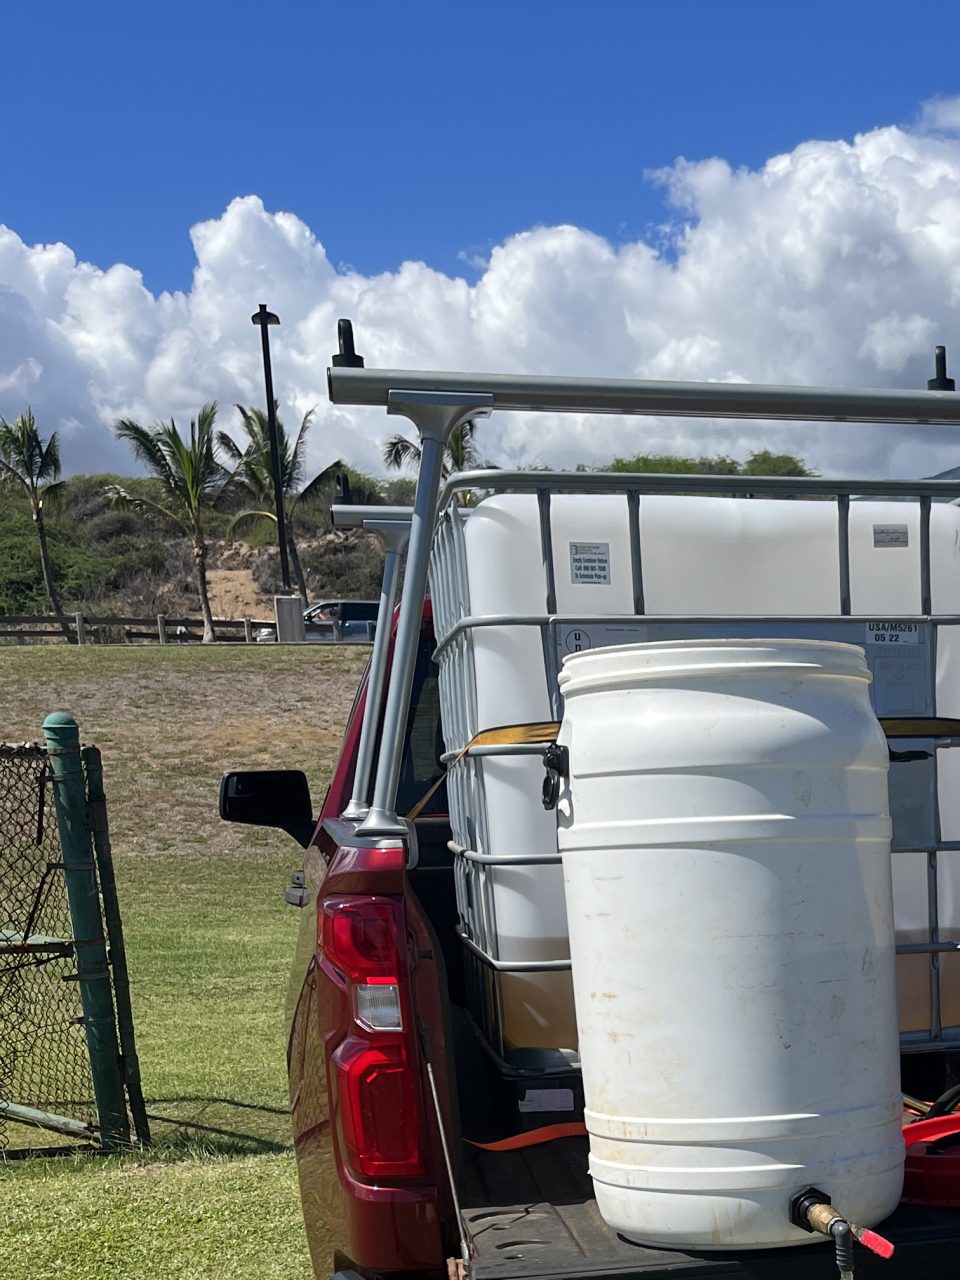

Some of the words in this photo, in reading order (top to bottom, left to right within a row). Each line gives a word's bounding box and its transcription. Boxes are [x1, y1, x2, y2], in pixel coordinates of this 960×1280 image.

[868, 623, 917, 633] USA/M5261
[874, 633, 886, 642] 05
[888, 633, 900, 643] 22
